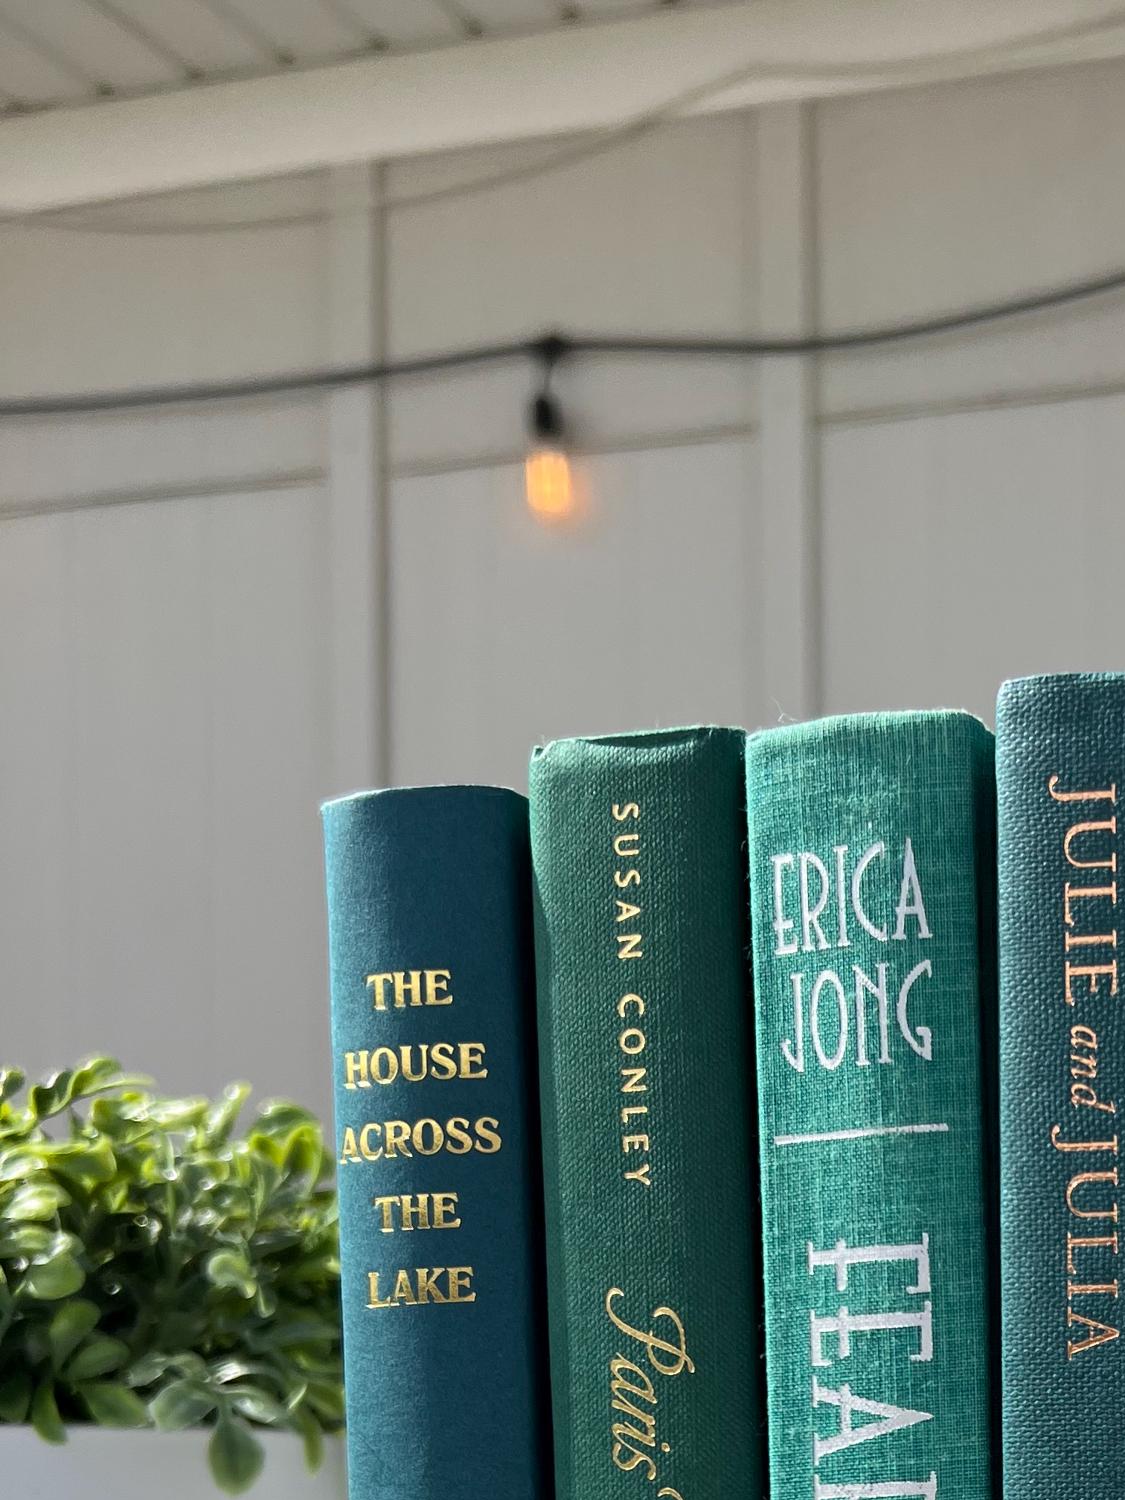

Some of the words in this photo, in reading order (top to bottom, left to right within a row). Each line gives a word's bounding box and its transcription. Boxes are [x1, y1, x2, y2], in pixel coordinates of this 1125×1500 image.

[611, 801, 643, 961] SUSAN
[769, 837, 934, 957] ERICA
[1048, 775, 1118, 1006] JULIE
[366, 968, 453, 1012] THE
[779, 958, 934, 1074] JONG
[343, 1041, 488, 1090] HOUSE
[615, 992, 652, 1188] CONLEY
[1068, 1024, 1115, 1112] and
[340, 1117, 502, 1164] ACROSS
[375, 1192, 462, 1233] THE
[1050, 1125, 1120, 1360] JULIA
[365, 1266, 476, 1309] LAKE
[605, 1286, 696, 1483] Paris
